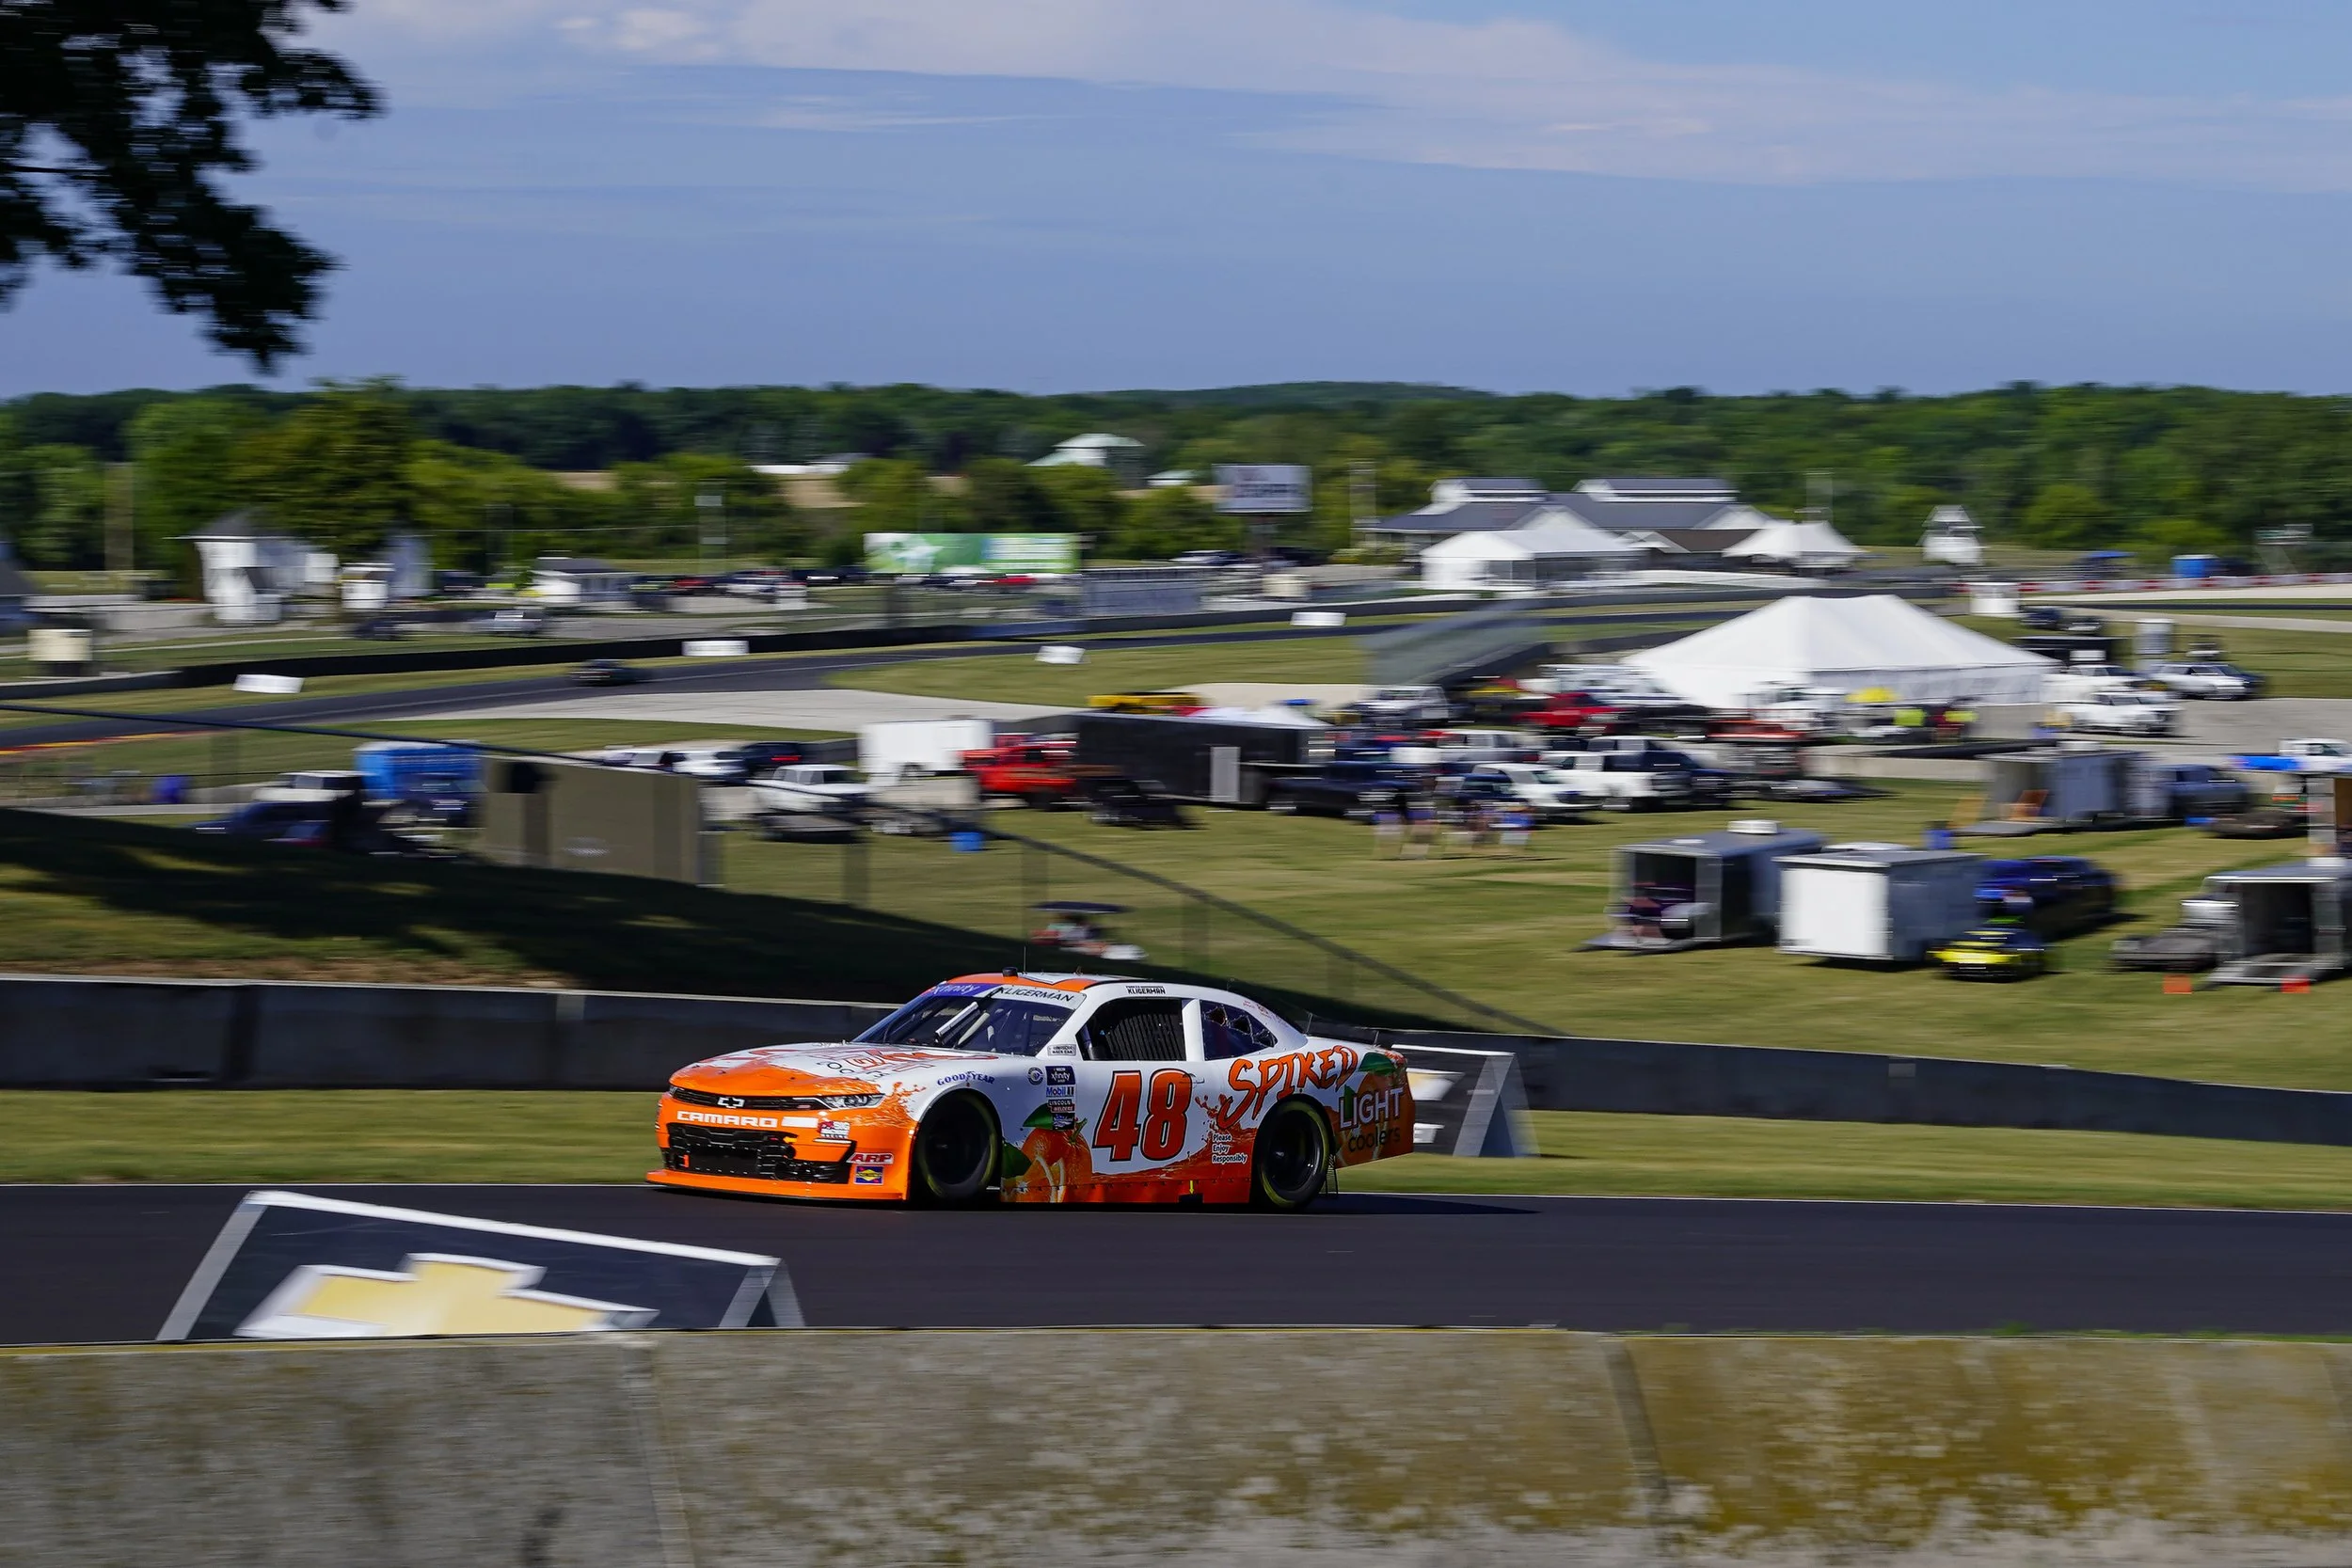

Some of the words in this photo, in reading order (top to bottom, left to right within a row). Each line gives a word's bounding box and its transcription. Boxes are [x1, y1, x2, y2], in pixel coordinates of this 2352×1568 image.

[937, 1071, 995, 1085] GOODYEAR
[1046, 1086, 1066, 1098] Mobil
[1217, 1045, 1359, 1129] SPIKED
[1092, 1068, 1193, 1162] 48
[1340, 1087, 1404, 1129] LIGHT
[676, 1110, 778, 1128] CAMARO
[1213, 1132, 1232, 1141] Please
[1348, 1130, 1401, 1153] coolers
[1213, 1144, 1230, 1153] Enjoy
[850, 1154, 892, 1163] ARP
[1213, 1154, 1248, 1164] Responsibly
